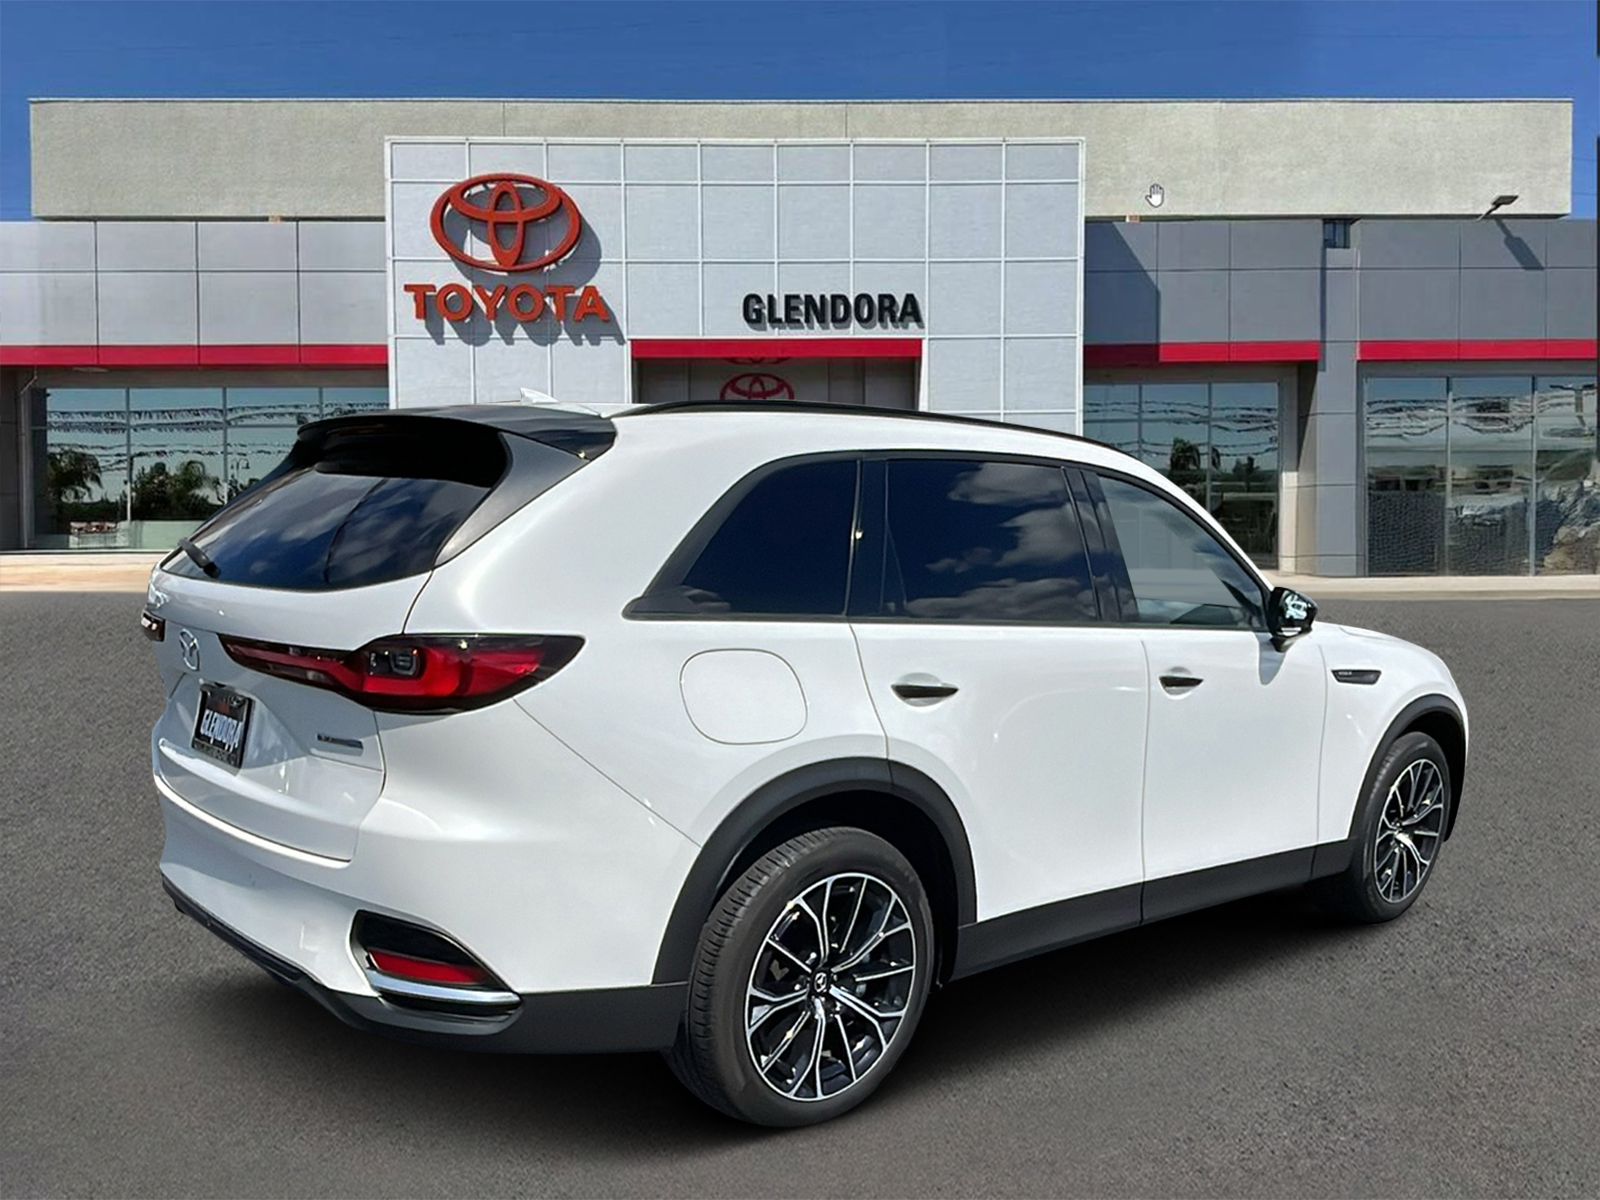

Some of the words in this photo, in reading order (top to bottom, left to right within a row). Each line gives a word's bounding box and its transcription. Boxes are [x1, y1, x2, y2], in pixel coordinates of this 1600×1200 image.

[403, 283, 611, 323] TOYOTA
[742, 292, 923, 327] GLENDORA
[200, 709, 242, 752] GLENDORA
